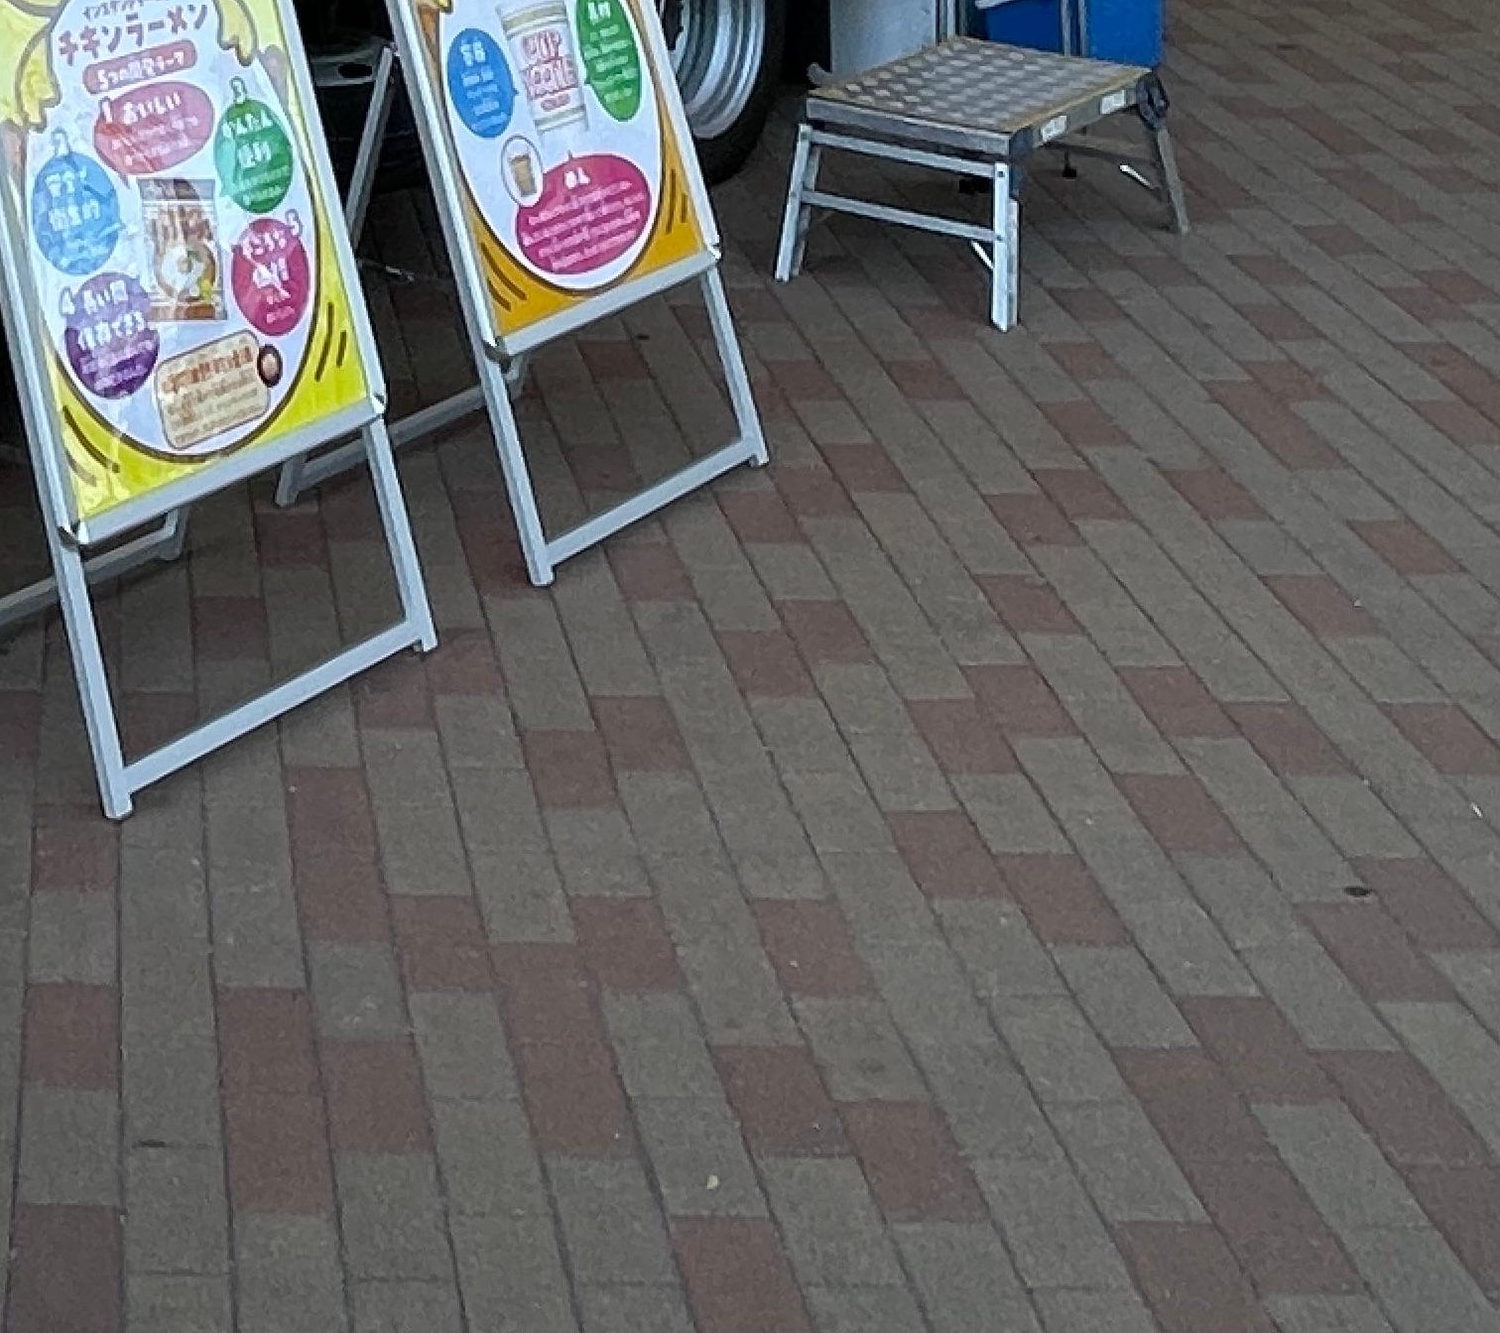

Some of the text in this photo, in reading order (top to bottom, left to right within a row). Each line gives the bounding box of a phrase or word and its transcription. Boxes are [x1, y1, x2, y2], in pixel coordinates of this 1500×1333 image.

[58, 3, 209, 66] チキンラーメン
[122, 91, 182, 126] おいしい
